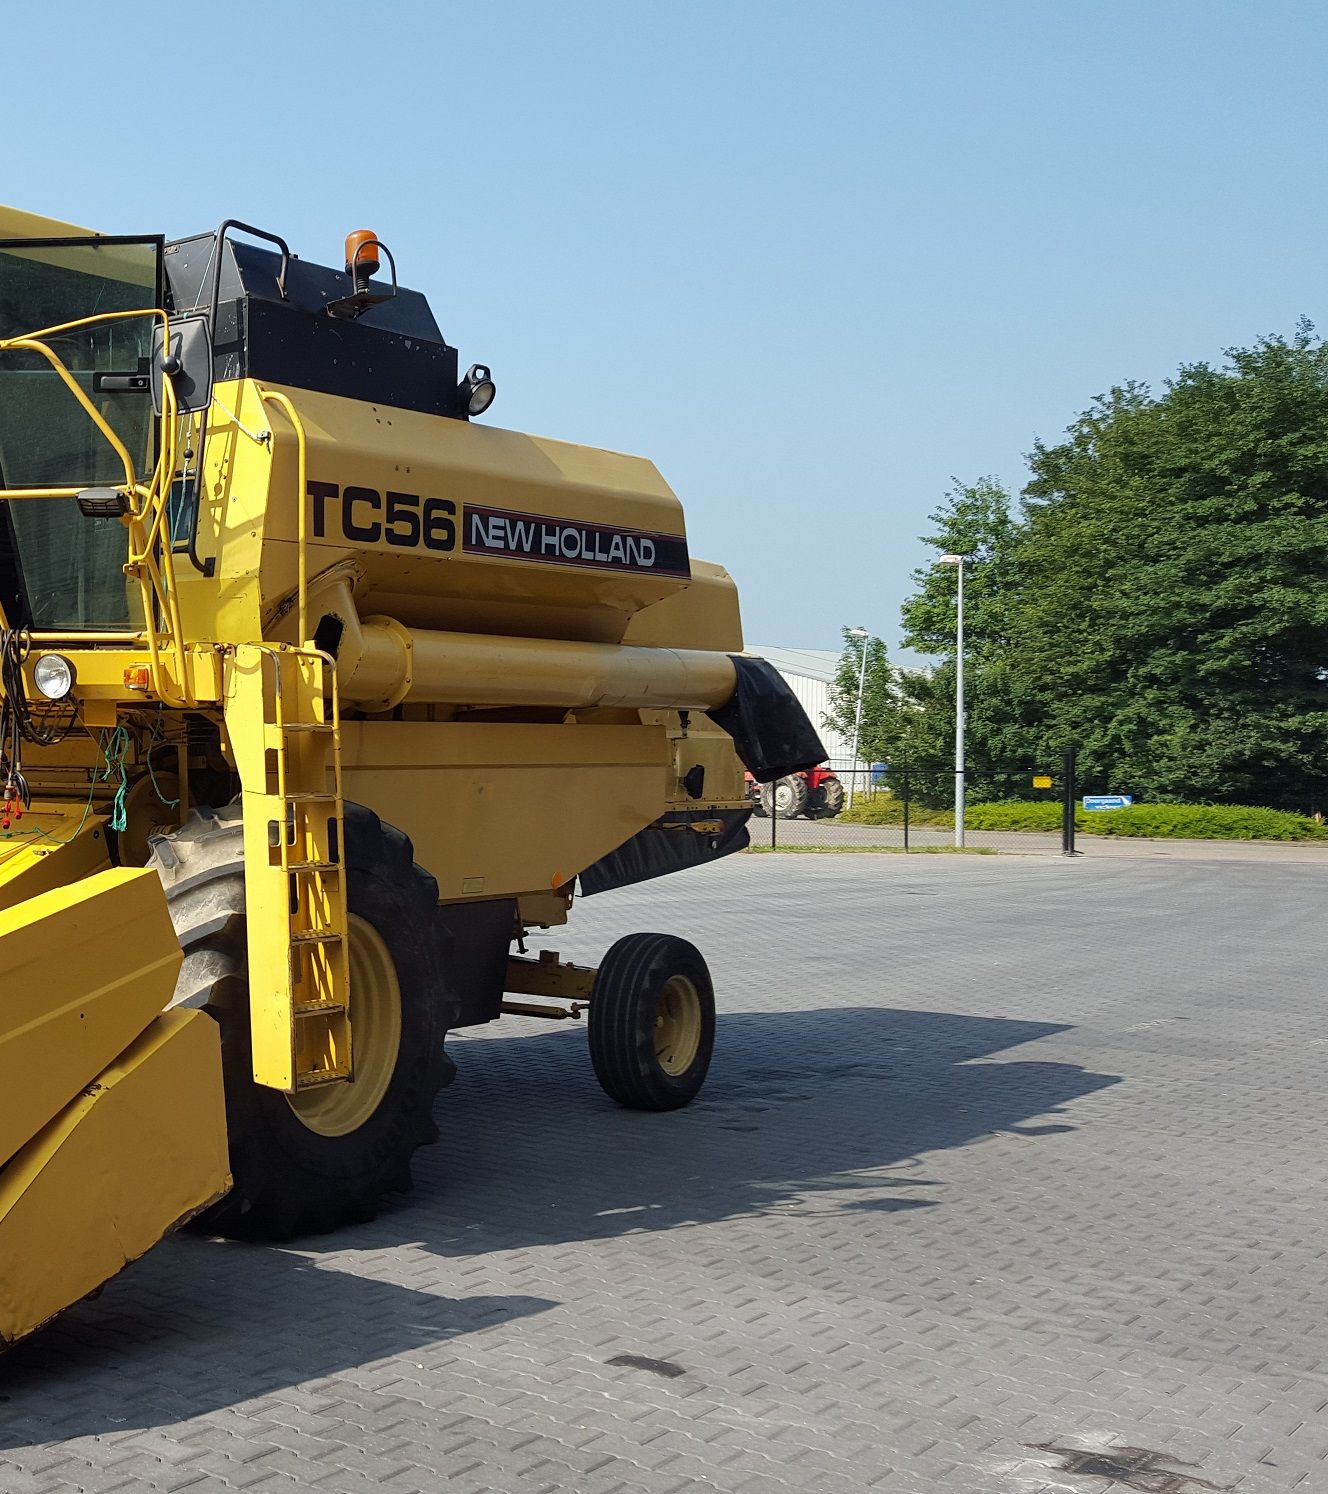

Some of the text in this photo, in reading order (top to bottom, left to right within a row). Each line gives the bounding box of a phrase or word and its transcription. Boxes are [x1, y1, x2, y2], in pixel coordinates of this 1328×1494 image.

[307, 480, 456, 551] TC56
[471, 514, 656, 567] NEW HOLLAND
